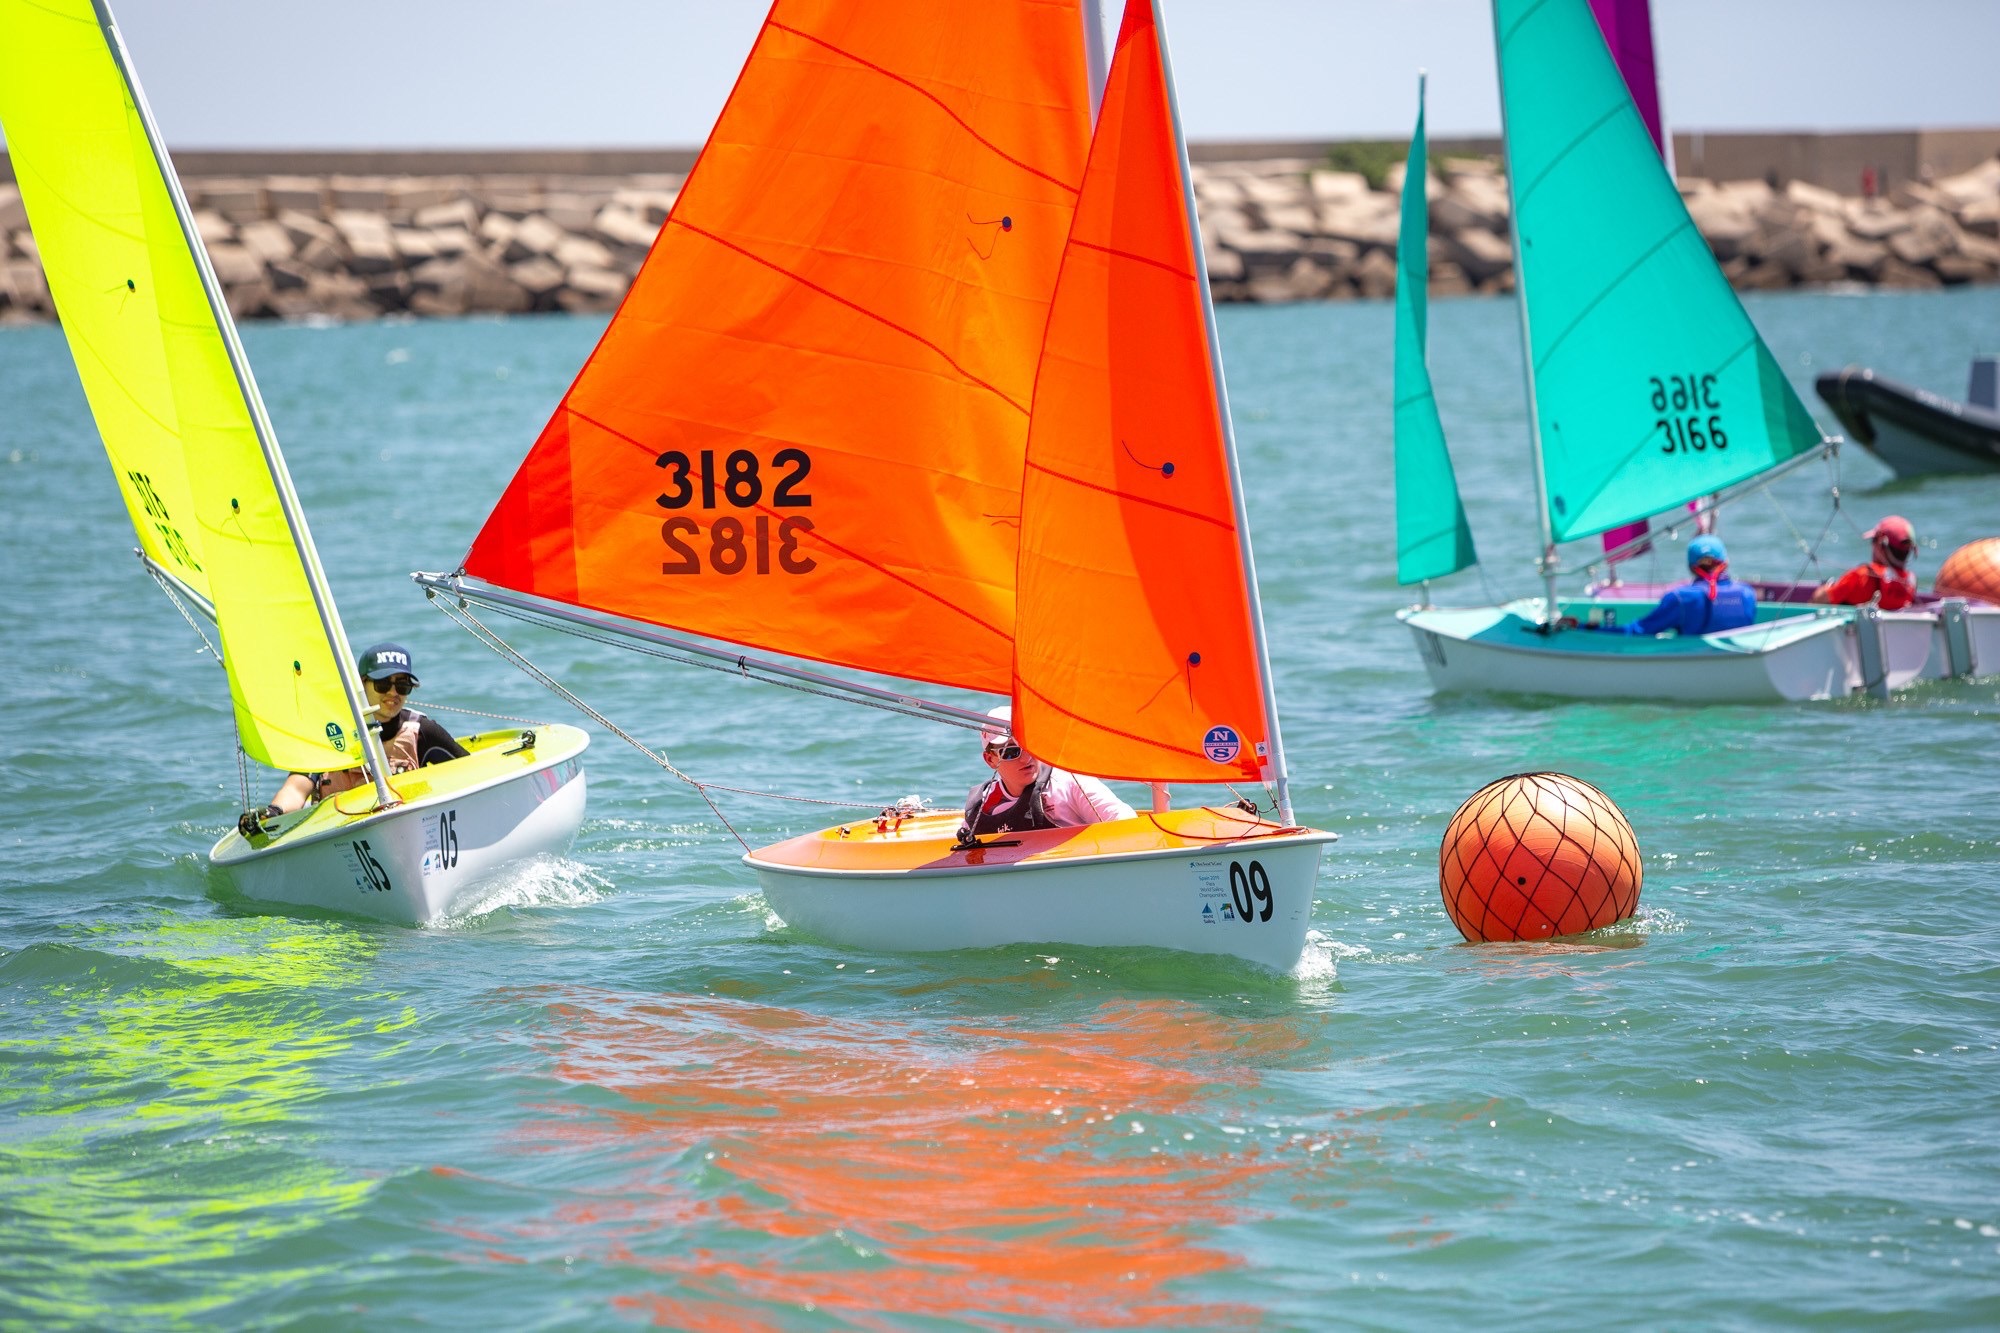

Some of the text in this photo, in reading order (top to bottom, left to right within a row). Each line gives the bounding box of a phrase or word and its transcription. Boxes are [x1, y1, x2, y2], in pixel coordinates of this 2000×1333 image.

[1656, 415, 1728, 454] 3166
[655, 448, 812, 510] 3182
[1212, 731, 1230, 742] N
[1213, 747, 1230, 759] S
[352, 839, 392, 892] 05
[441, 810, 458, 871] 05
[1230, 860, 1273, 923] 09
